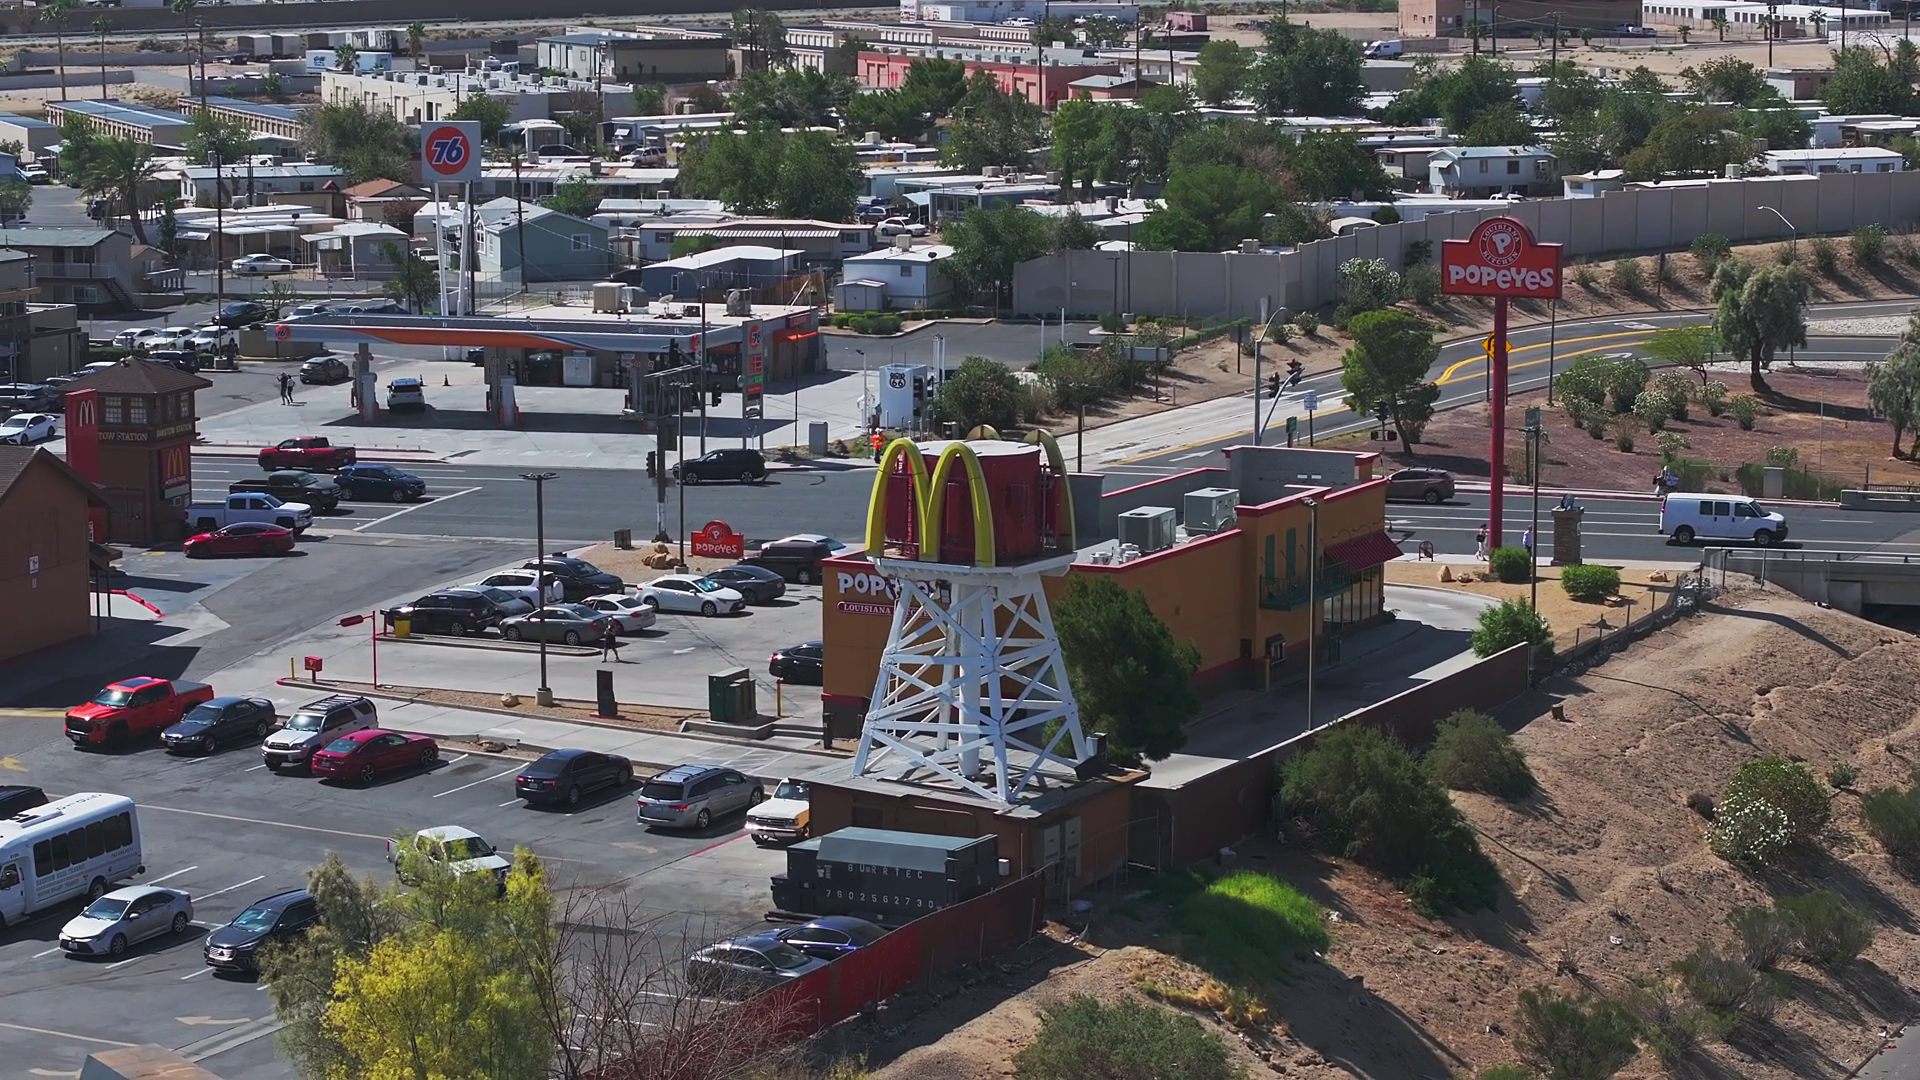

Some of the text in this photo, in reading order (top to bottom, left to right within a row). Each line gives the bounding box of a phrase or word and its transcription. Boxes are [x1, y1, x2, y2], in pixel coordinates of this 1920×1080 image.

[431, 136, 466, 165] 76
[1481, 222, 1522, 242] LOUISIANA
[1482, 251, 1519, 266] KITCHEN
[891, 379, 904, 387] 66
[116, 431, 148, 441] STATION
[843, 603, 892, 614] LOUISIANA
[825, 889, 934, 909] 7602562730
